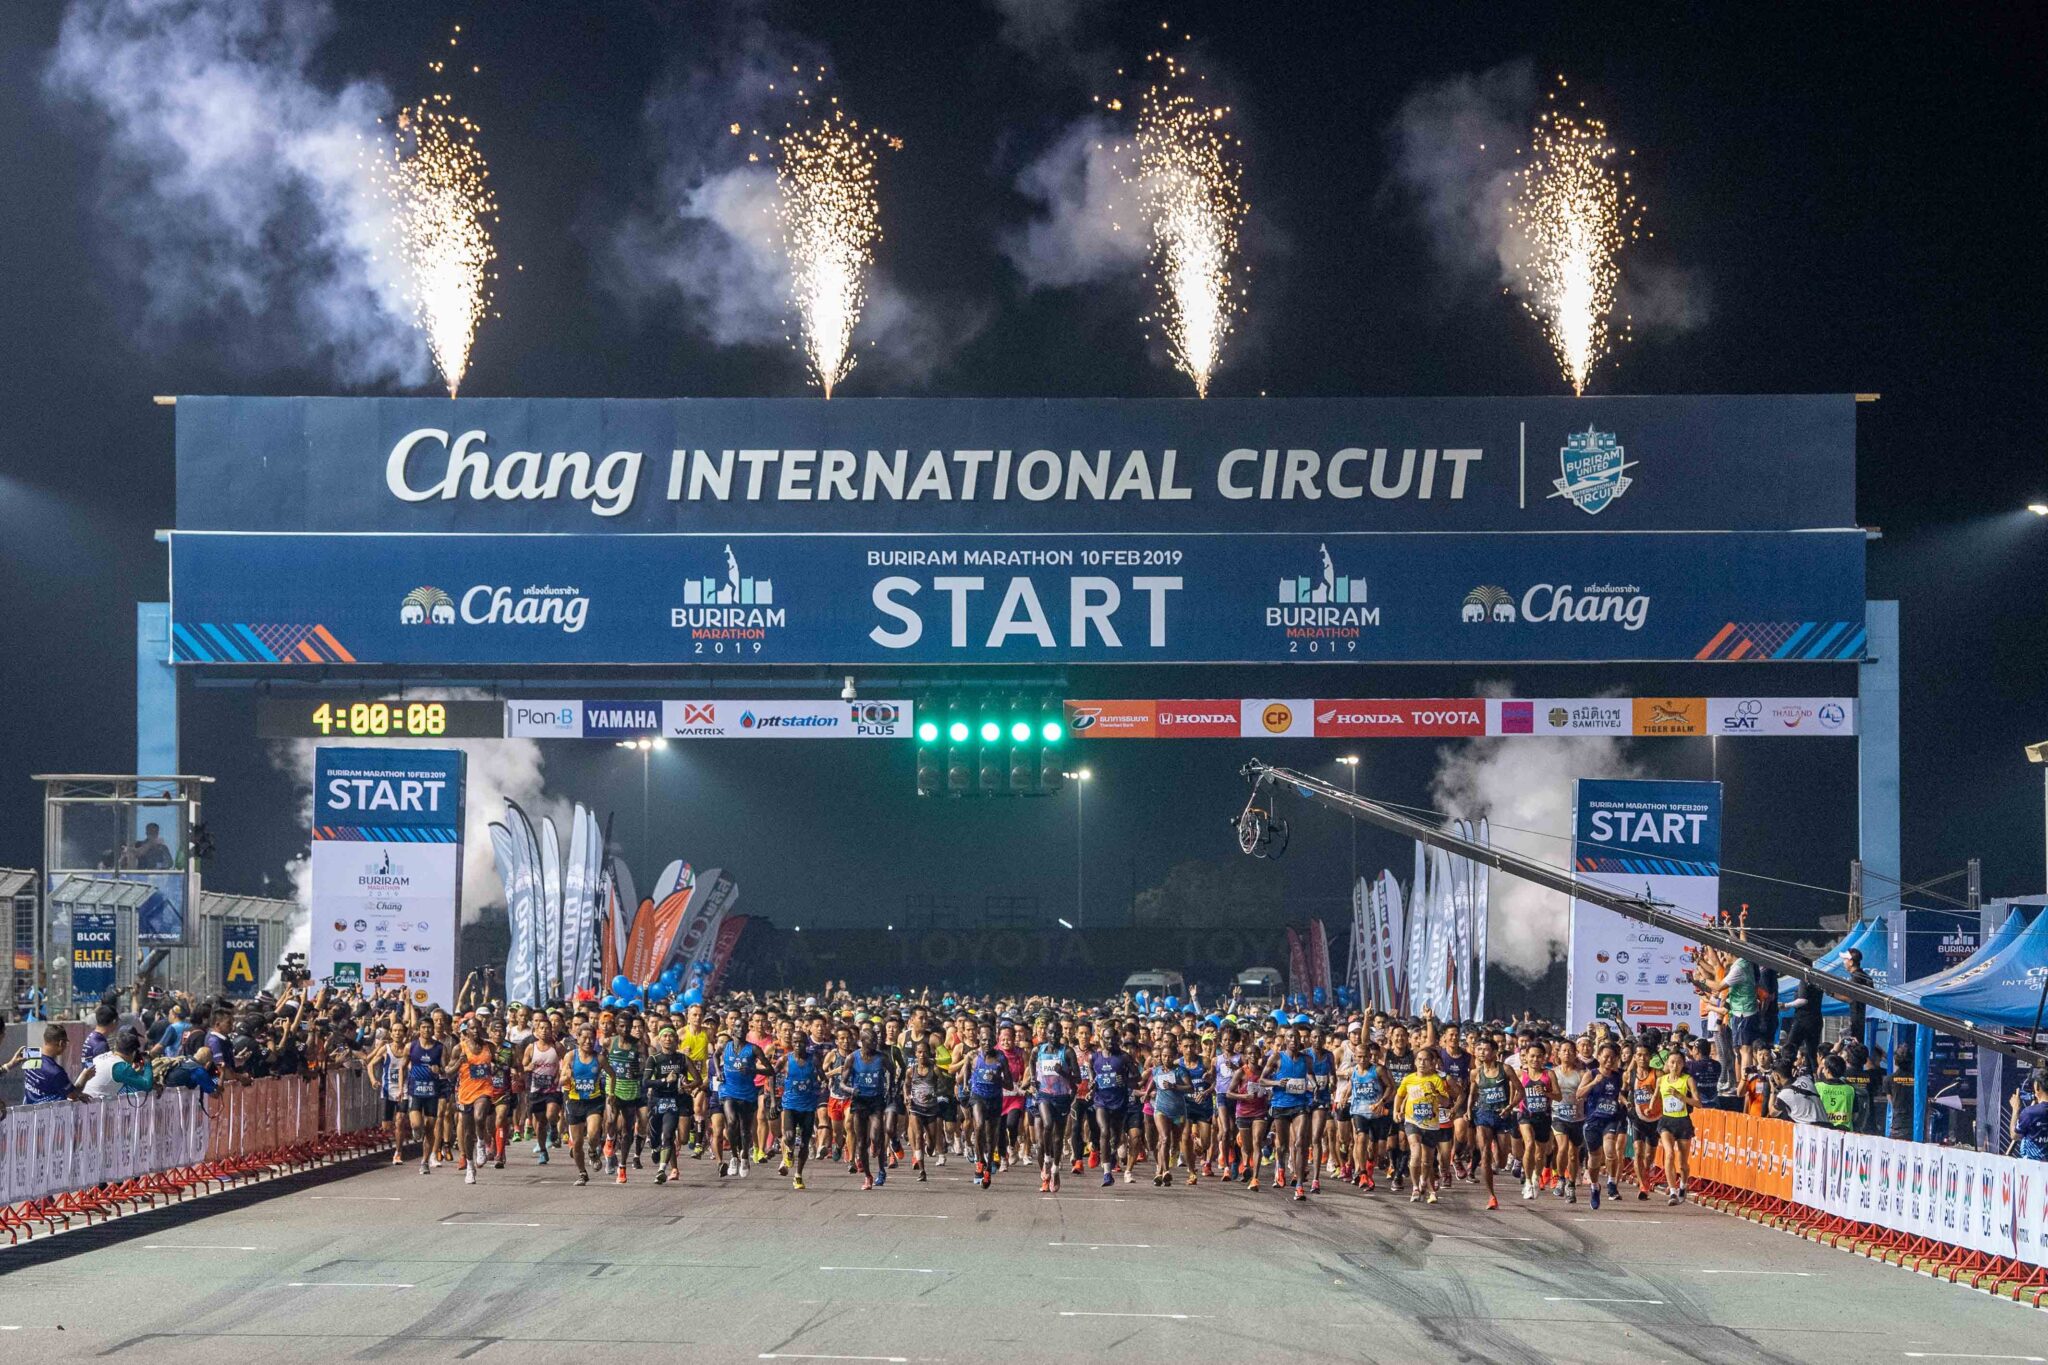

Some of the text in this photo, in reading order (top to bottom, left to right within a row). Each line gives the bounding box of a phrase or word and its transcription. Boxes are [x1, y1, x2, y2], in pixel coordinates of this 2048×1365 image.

[1566, 449, 1620, 472] BURIRAM
[386, 427, 1483, 516] Chang INTERNATIONAL CIRCUIT
[1576, 462, 1609, 477] UNITED
[867, 550, 957, 566] BURIRAM
[964, 550, 1073, 566] MARATHON
[460, 584, 590, 633] Chang
[868, 576, 1184, 649] START
[1521, 583, 1651, 631] Chang
[671, 608, 786, 628] BURIRAM
[1266, 607, 1380, 627] BURIRAM
[692, 628, 765, 639] MARATHON
[1286, 627, 1360, 638] MARATHON
[312, 703, 445, 734] 4:00:08
[851, 702, 899, 725] 100
[1265, 711, 1288, 726] CP
[1411, 711, 1480, 725] TOYOTA
[1572, 706, 1621, 720] สมิติเวช
[588, 710, 657, 729] YAMAHA
[1175, 714, 1237, 724] HONDA
[1337, 714, 1404, 724] HONDA
[1572, 720, 1621, 728] SAMITIVEJ
[1724, 717, 1758, 728] SAT
[674, 728, 726, 736] WARRIX
[857, 725, 895, 736] PLUS
[1643, 725, 1668, 733] TIGER
[363, 770, 405, 778] MARATHON
[327, 778, 446, 812] START
[1589, 801, 1624, 809] BURIRAM
[1625, 803, 1667, 811] MARATHON
[1590, 810, 1708, 844] START
[358, 876, 410, 886] BURIRAM
[376, 901, 402, 912] Chang
[77, 933, 110, 941] BLOCK
[1638, 934, 1664, 944] Chang
[1938, 945, 1979, 953] BURIRAM
[74, 950, 112, 961] ELITE
[227, 952, 254, 982] A
[1830, 1098, 1836, 1106] 5
[1828, 1113, 1848, 1121] ikon
